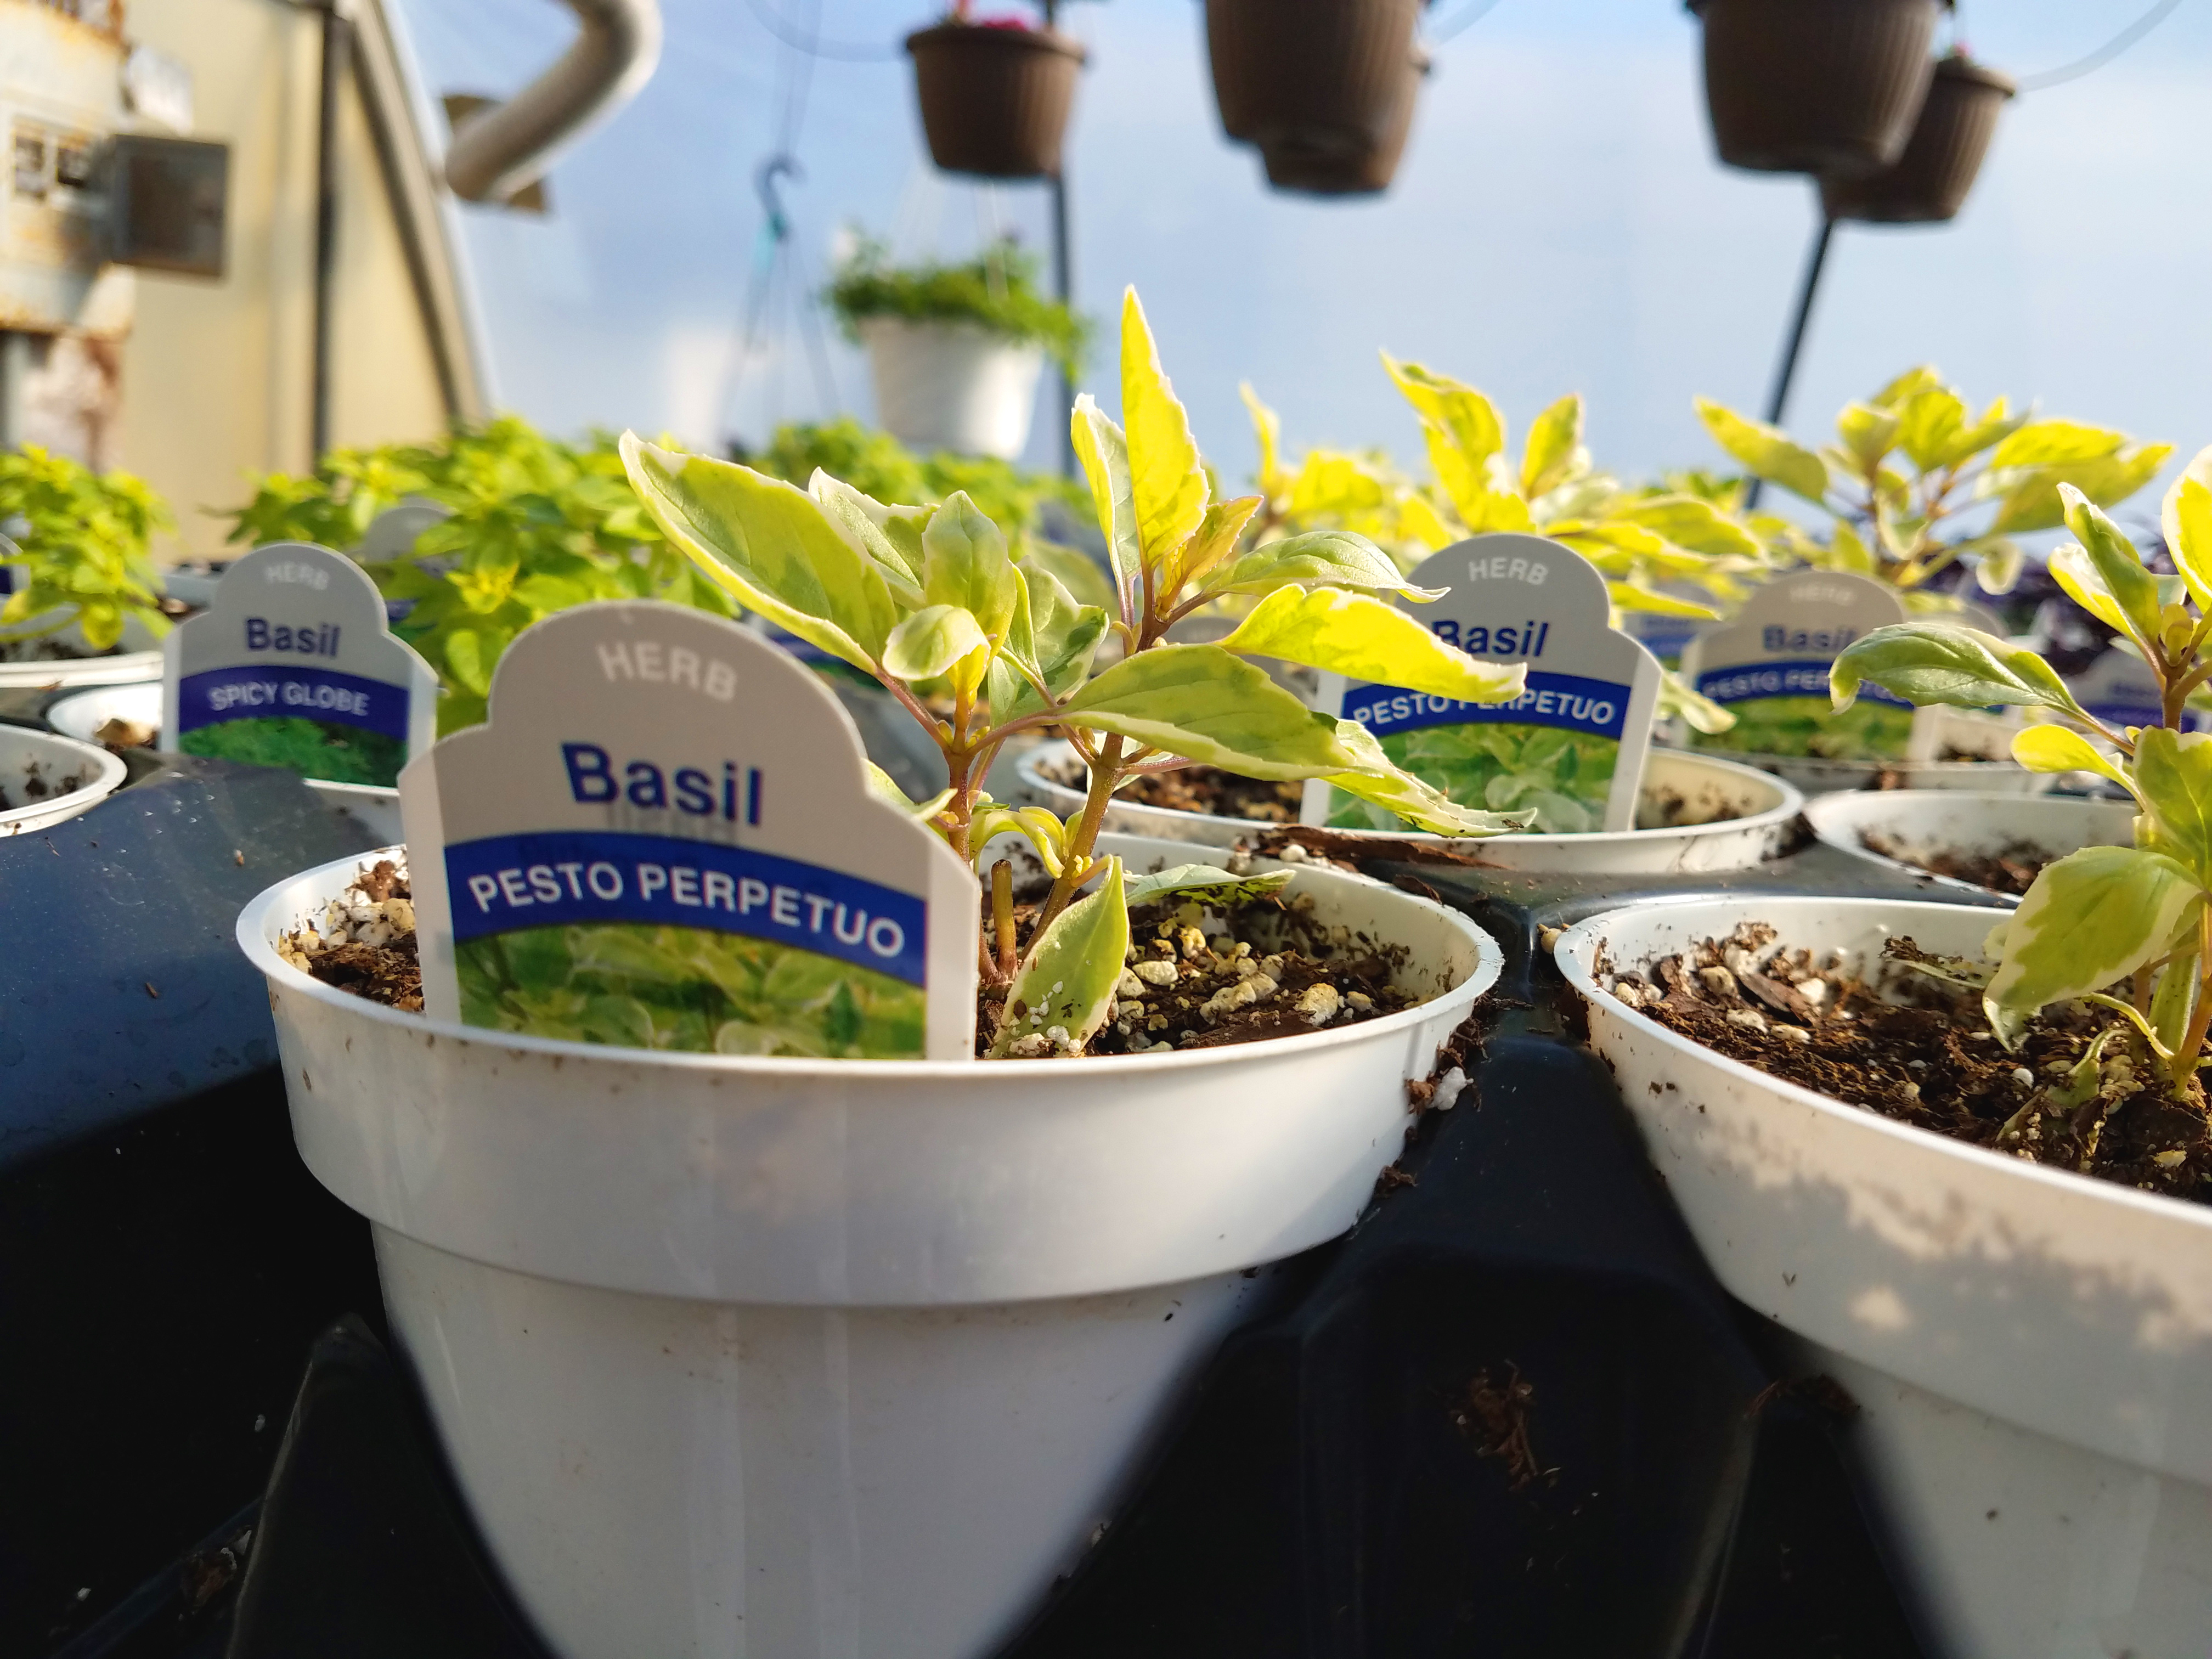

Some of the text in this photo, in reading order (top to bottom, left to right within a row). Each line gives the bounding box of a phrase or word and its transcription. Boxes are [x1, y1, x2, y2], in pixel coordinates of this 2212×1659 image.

[265, 561, 329, 591] HERB
[1468, 556, 1549, 585] HERB
[245, 617, 341, 659] Basil
[1431, 620, 1550, 658] Basil
[596, 641, 737, 701] HERB
[208, 681, 370, 717] SPICY GLOBE
[1352, 688, 1615, 726] PESTO PETUO
[560, 740, 763, 829] Basil
[468, 861, 905, 958] PESTO PERPETUO
